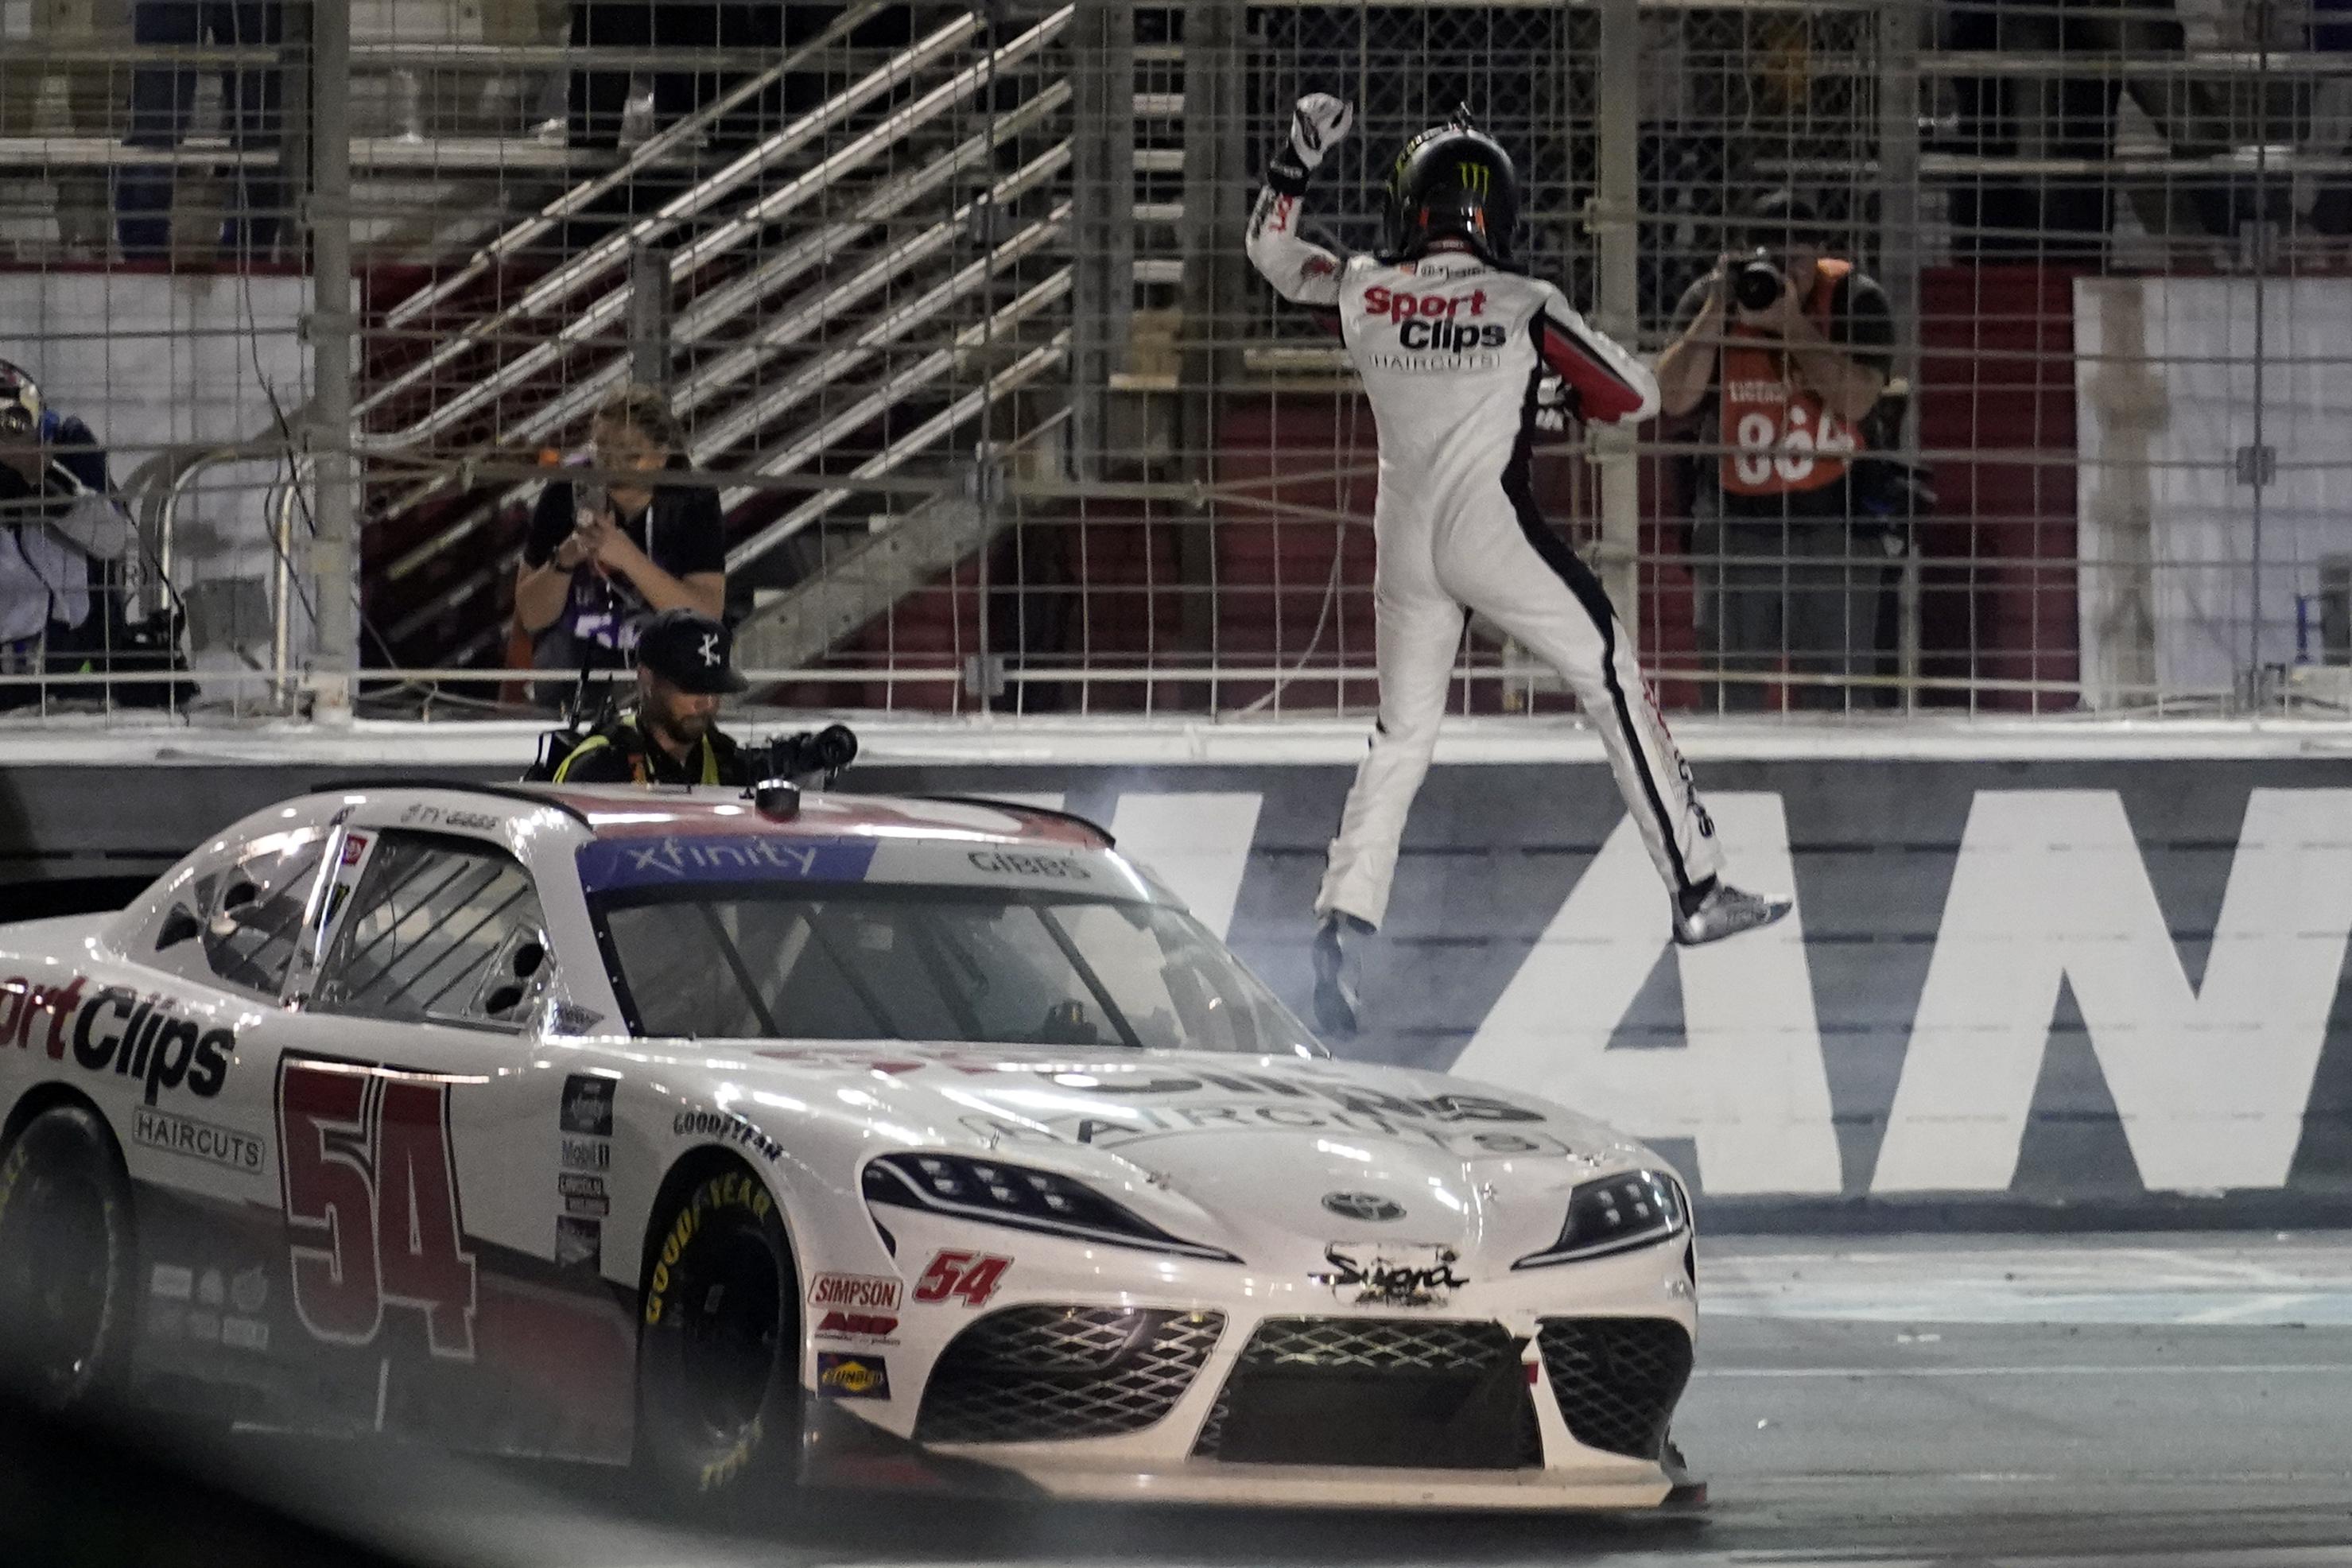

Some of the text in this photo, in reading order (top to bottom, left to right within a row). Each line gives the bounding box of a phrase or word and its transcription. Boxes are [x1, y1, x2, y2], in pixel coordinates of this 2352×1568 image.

[1364, 286, 1487, 325] Sport
[1399, 319, 1507, 355] Clips
[628, 836, 817, 877] xfinity
[967, 851, 1092, 879] GIBBS
[0, 974, 236, 1106] ort Clips
[138, 1113, 260, 1167] HAIRCUTS
[275, 1048, 476, 1359] 54
[815, 1277, 895, 1308] SIMPSON
[912, 1248, 1015, 1308] 54
